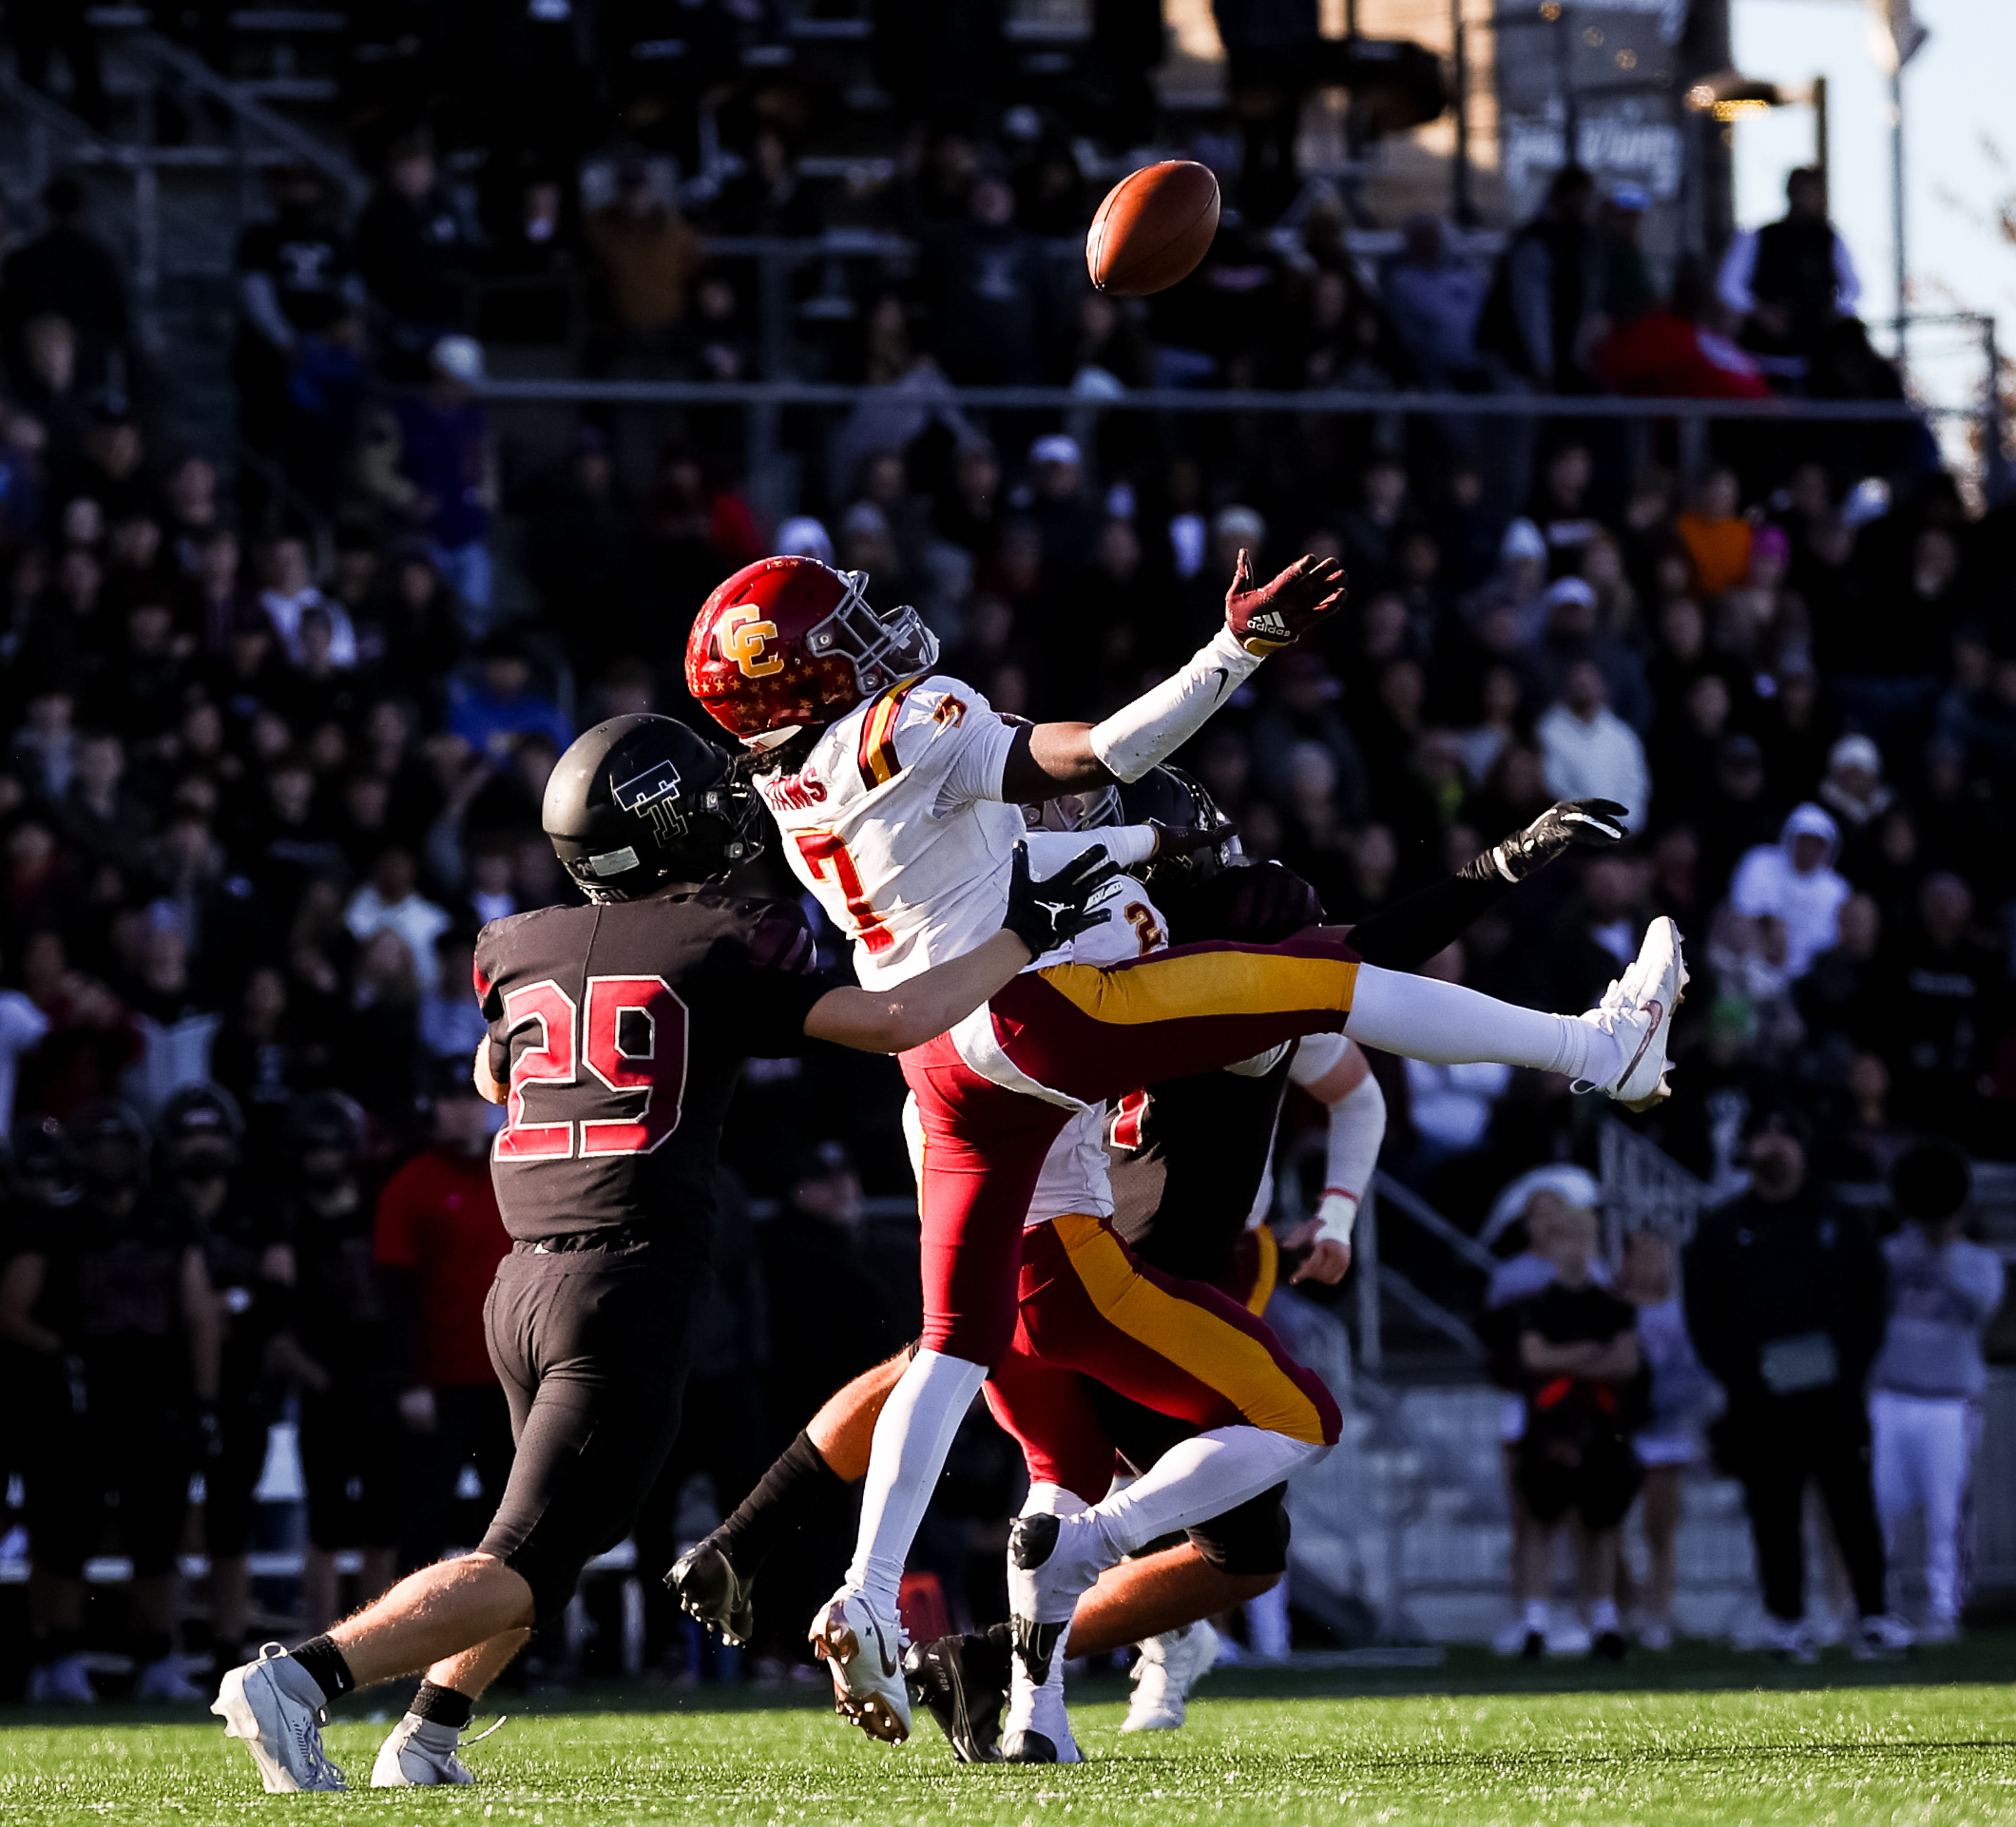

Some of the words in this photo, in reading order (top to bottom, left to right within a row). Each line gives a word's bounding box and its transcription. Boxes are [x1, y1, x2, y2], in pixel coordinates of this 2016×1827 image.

[1246, 620, 1291, 637] adidas
[789, 829, 895, 955] 7
[1124, 901, 1162, 956] 2
[493, 975, 689, 1162] 29
